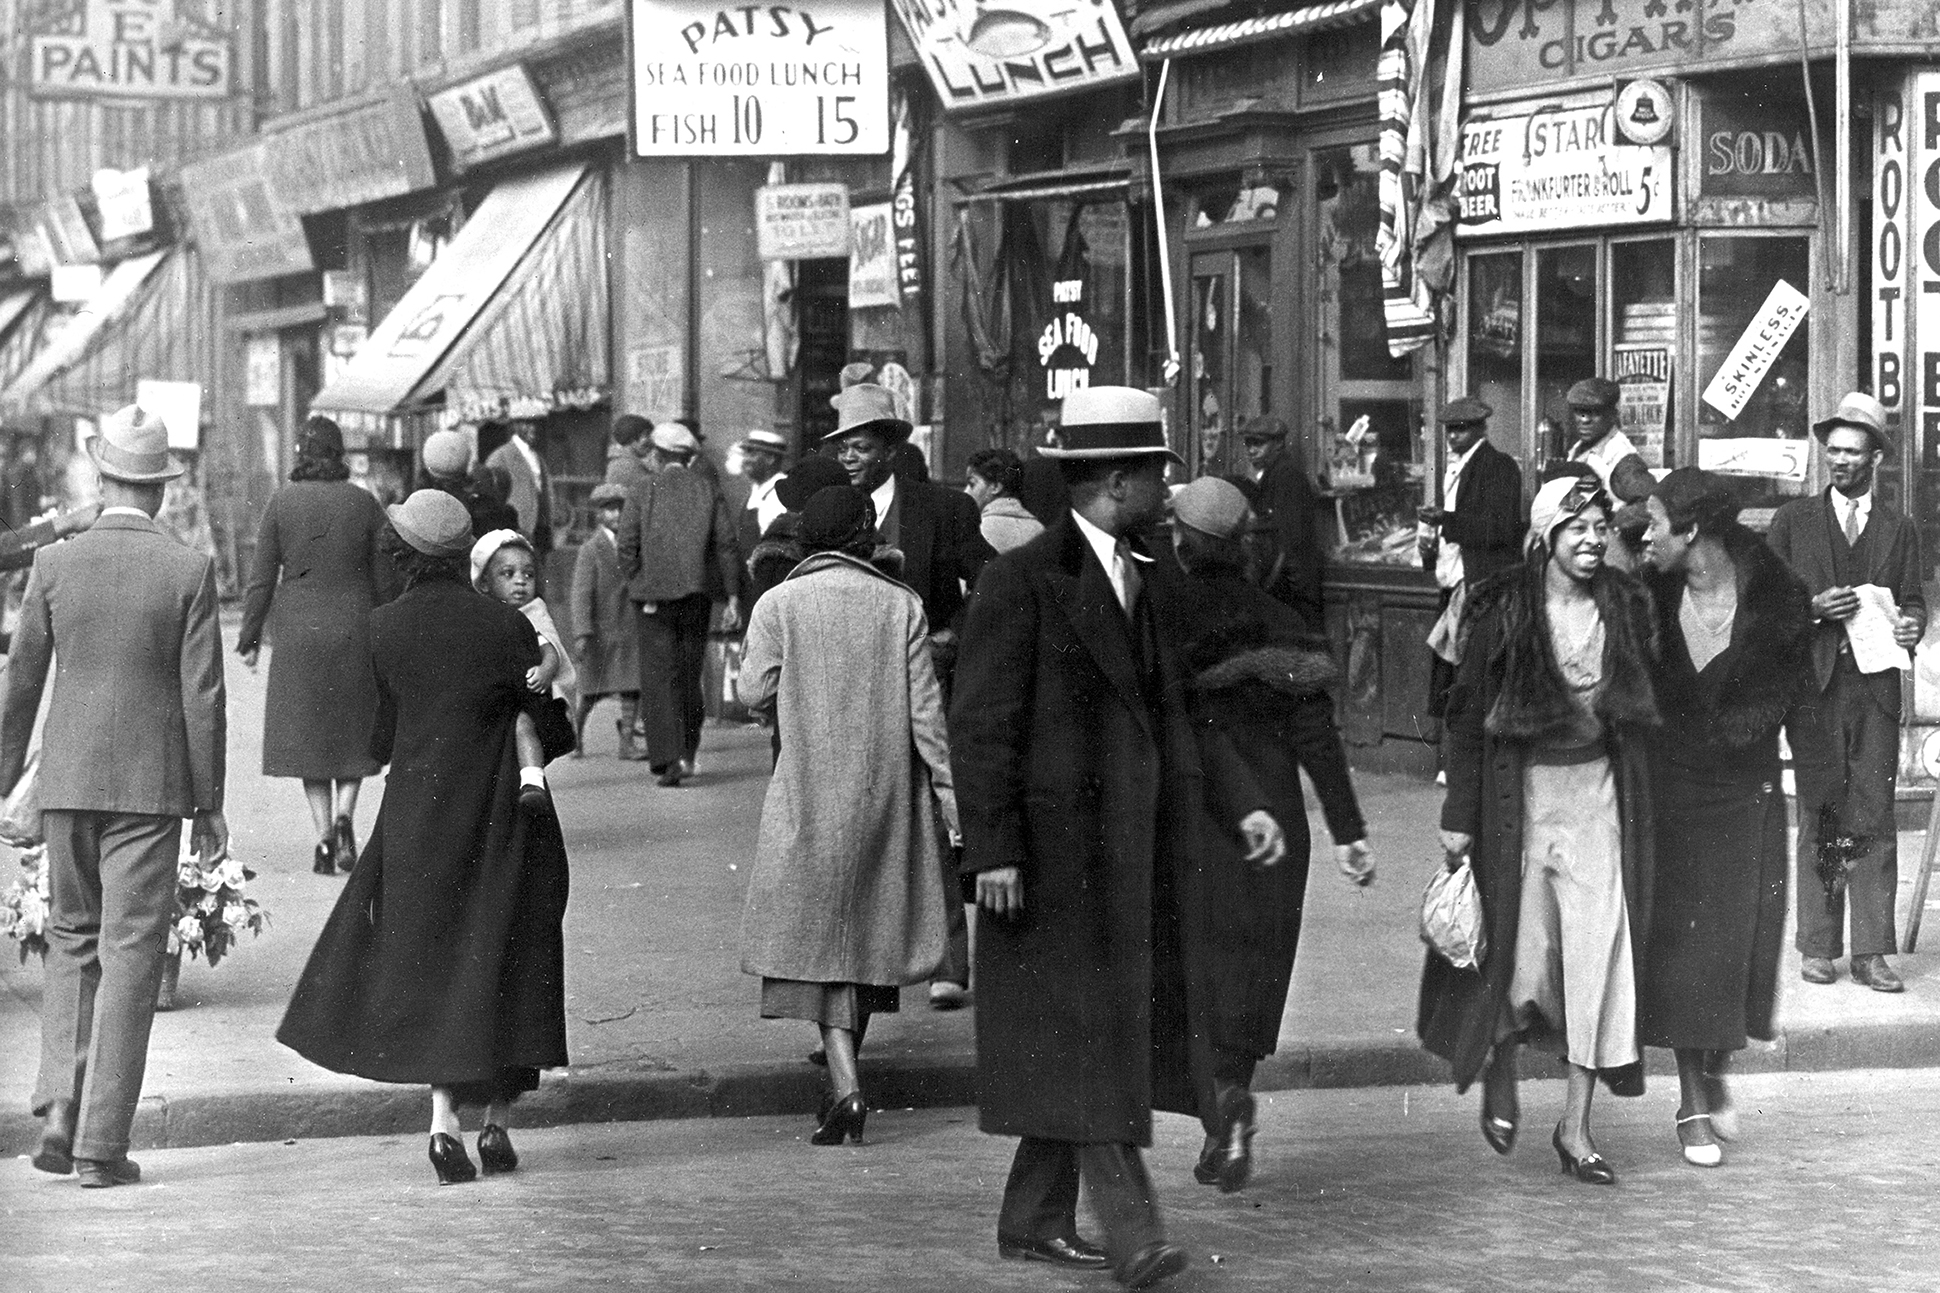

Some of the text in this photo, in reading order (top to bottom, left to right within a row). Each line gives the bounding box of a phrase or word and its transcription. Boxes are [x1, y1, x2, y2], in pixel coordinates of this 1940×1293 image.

[681, 6, 834, 54] PATSY
[1539, 10, 1736, 69] CIGARS
[43, 45, 222, 85] PAINTS
[647, 62, 862, 86] SEA FOOD LUNCH
[929, 16, 1122, 98] LUNCH
[652, 94, 860, 145] FISH 10 15
[1533, 116, 1600, 157] STAR
[1708, 130, 1812, 175] SODA
[1879, 100, 1902, 341] ROOT
[1038, 312, 1098, 366] SEA FOOD
[1724, 304, 1790, 396] SKINLESS
